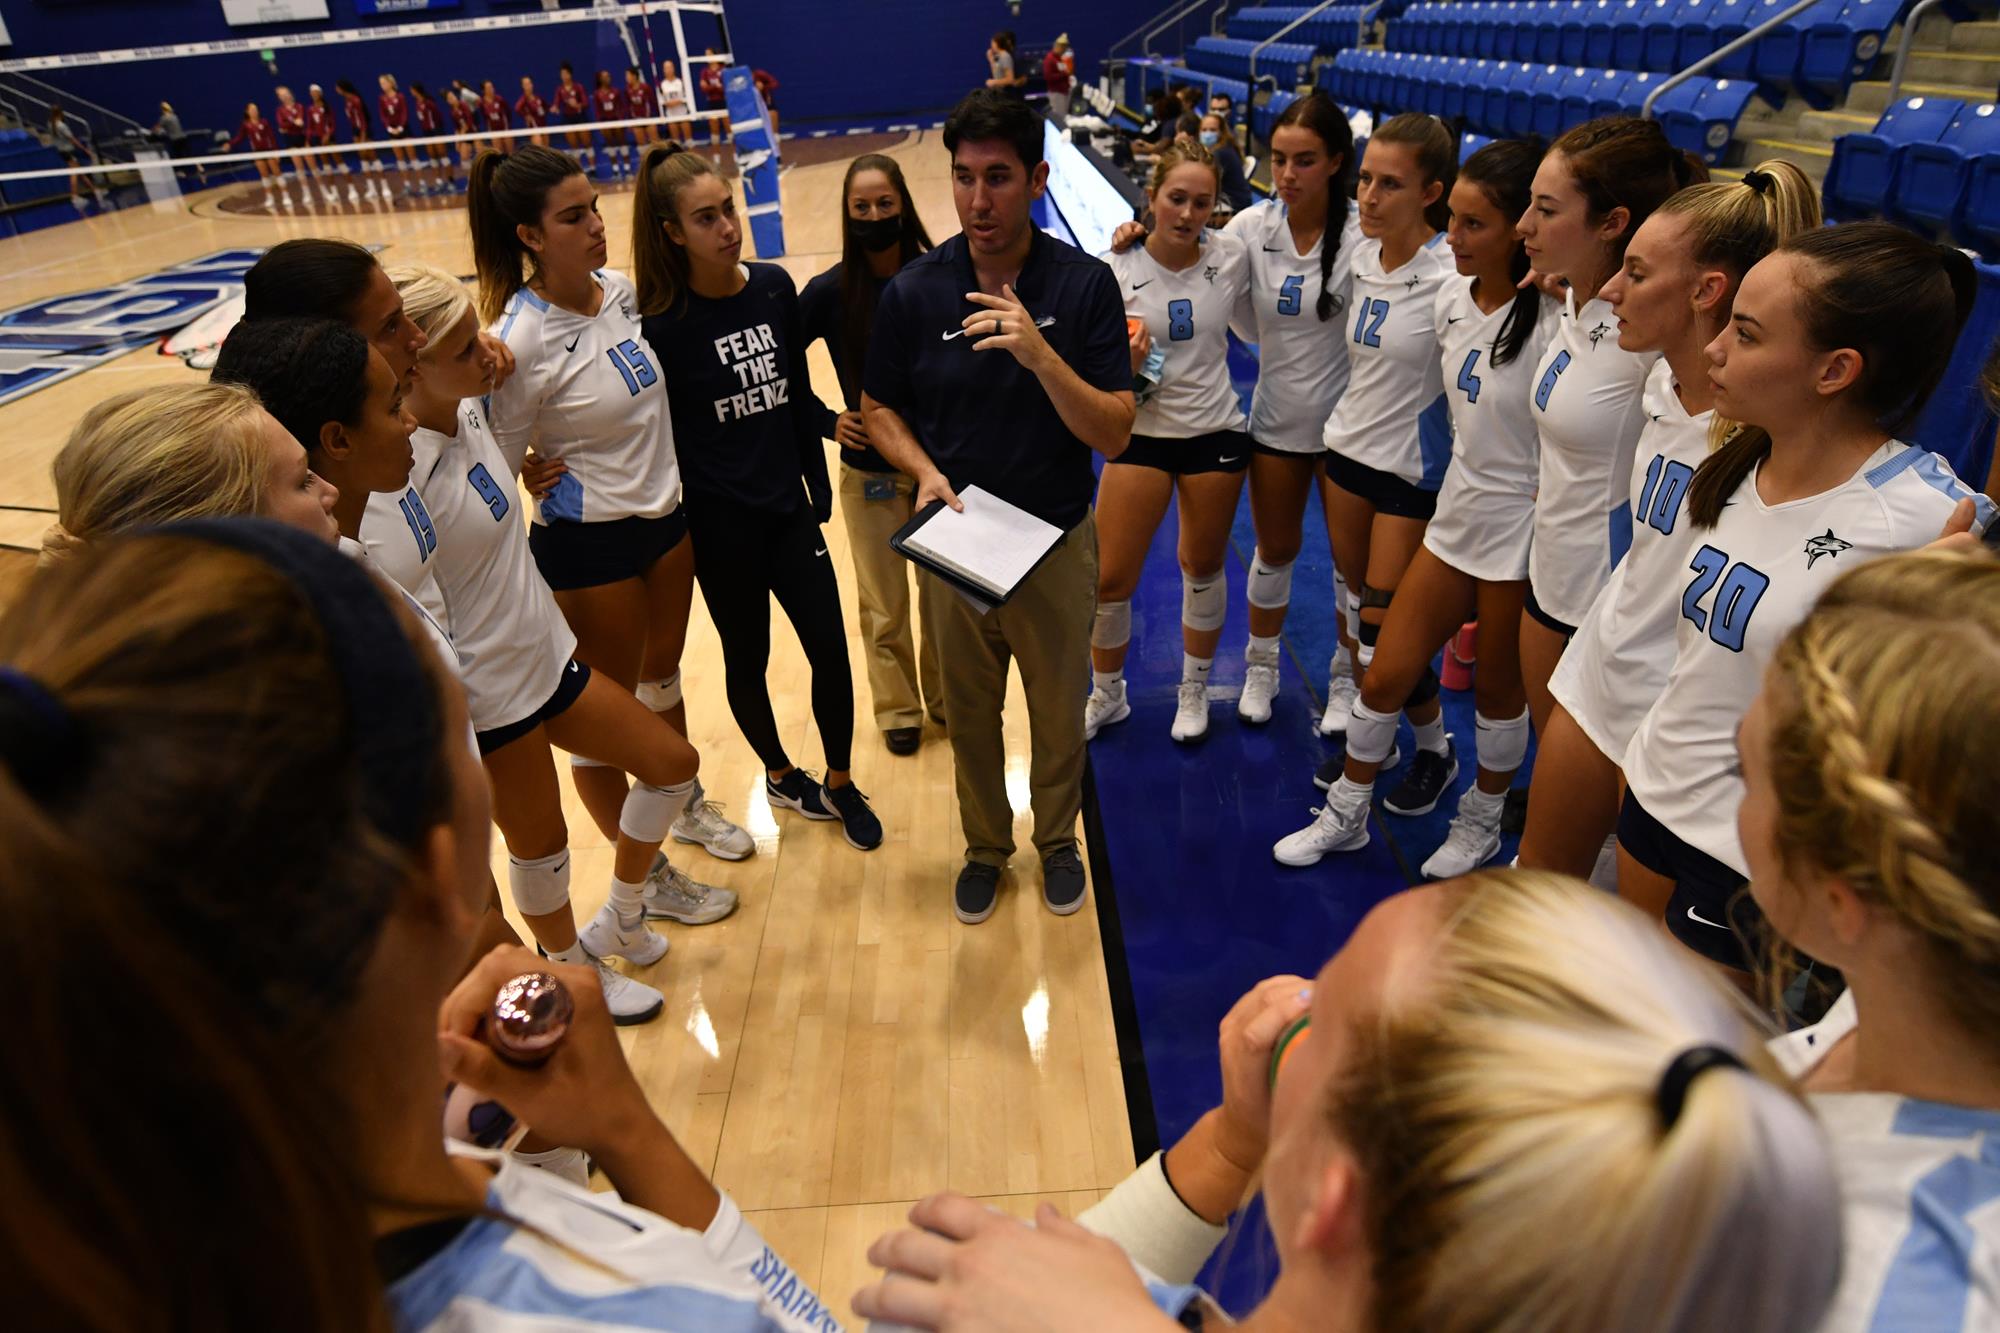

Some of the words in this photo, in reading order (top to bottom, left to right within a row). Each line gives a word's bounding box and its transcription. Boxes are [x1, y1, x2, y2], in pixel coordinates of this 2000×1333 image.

[1168, 299, 1194, 341] 8
[1277, 275, 1305, 316] 5
[1353, 296, 1390, 348] 12
[607, 338, 657, 397] 15
[714, 323, 778, 365] FEAR
[732, 352, 779, 390] THE
[1457, 349, 1482, 404] 4
[1535, 349, 1572, 412] 6
[467, 462, 509, 522] 9
[1636, 454, 1694, 535] 10
[398, 486, 437, 564] 19
[1682, 544, 1770, 653] 20
